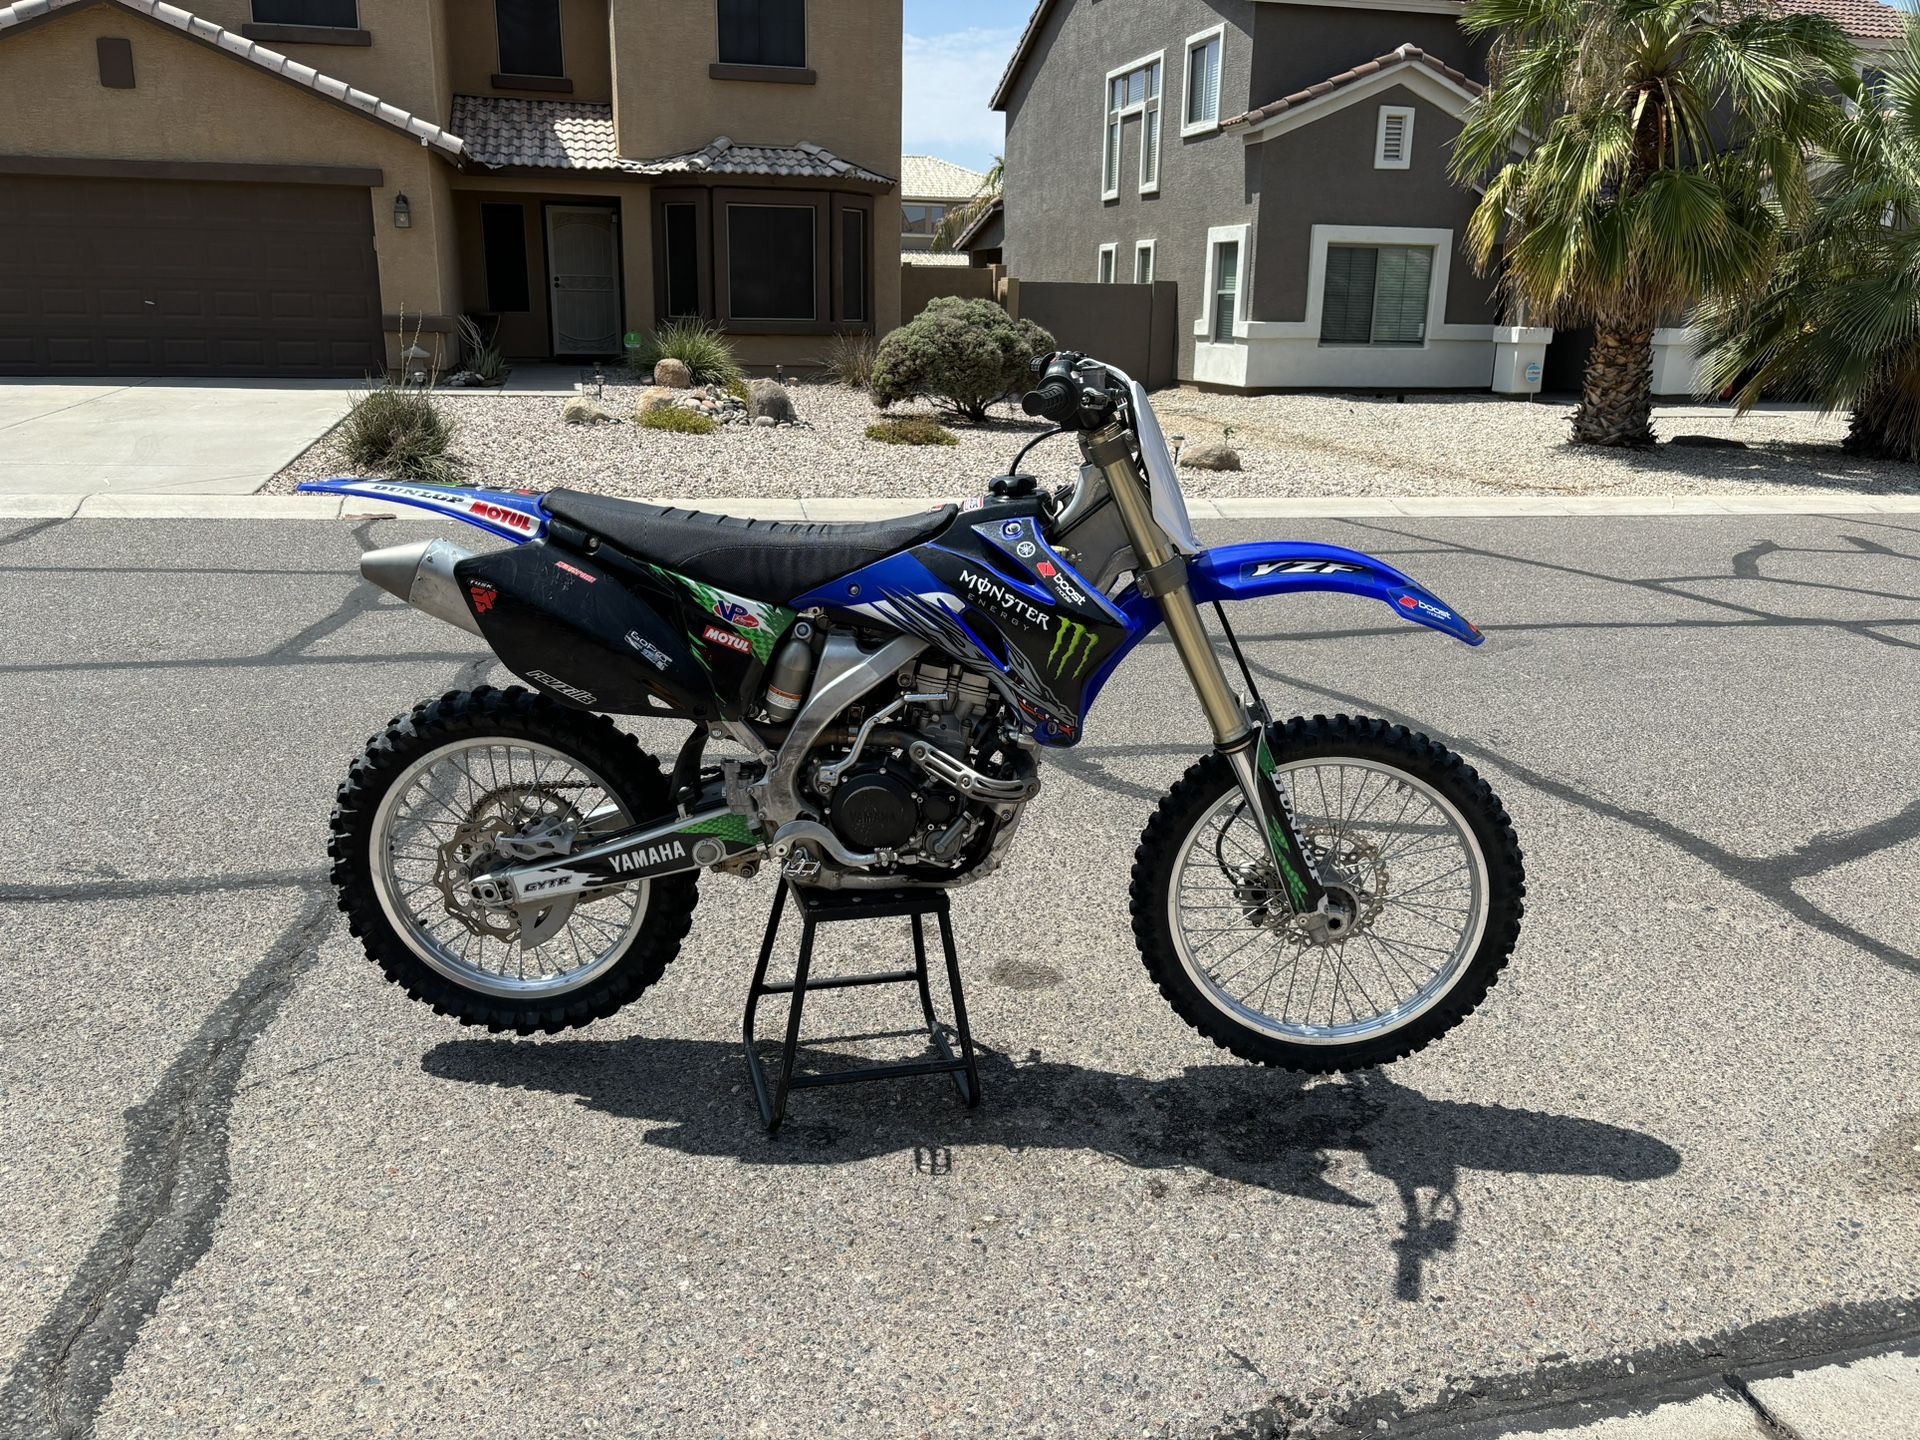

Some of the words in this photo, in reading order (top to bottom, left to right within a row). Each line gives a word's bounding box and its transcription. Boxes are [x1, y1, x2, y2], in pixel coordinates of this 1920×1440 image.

[371, 484, 465, 504] DUNLOP
[468, 501, 532, 532] MOTUL
[1250, 559, 1365, 577] YZF
[959, 569, 1050, 631] MONSTER
[1053, 572, 1086, 606] boost
[717, 599, 749, 623] VP
[967, 592, 1031, 632] ENERGY
[1418, 599, 1452, 620] boost
[705, 627, 750, 653] MOTUL
[1269, 771, 1324, 886] DUNLOP
[608, 840, 686, 873] YAMAHA
[523, 874, 573, 893] GYTR
